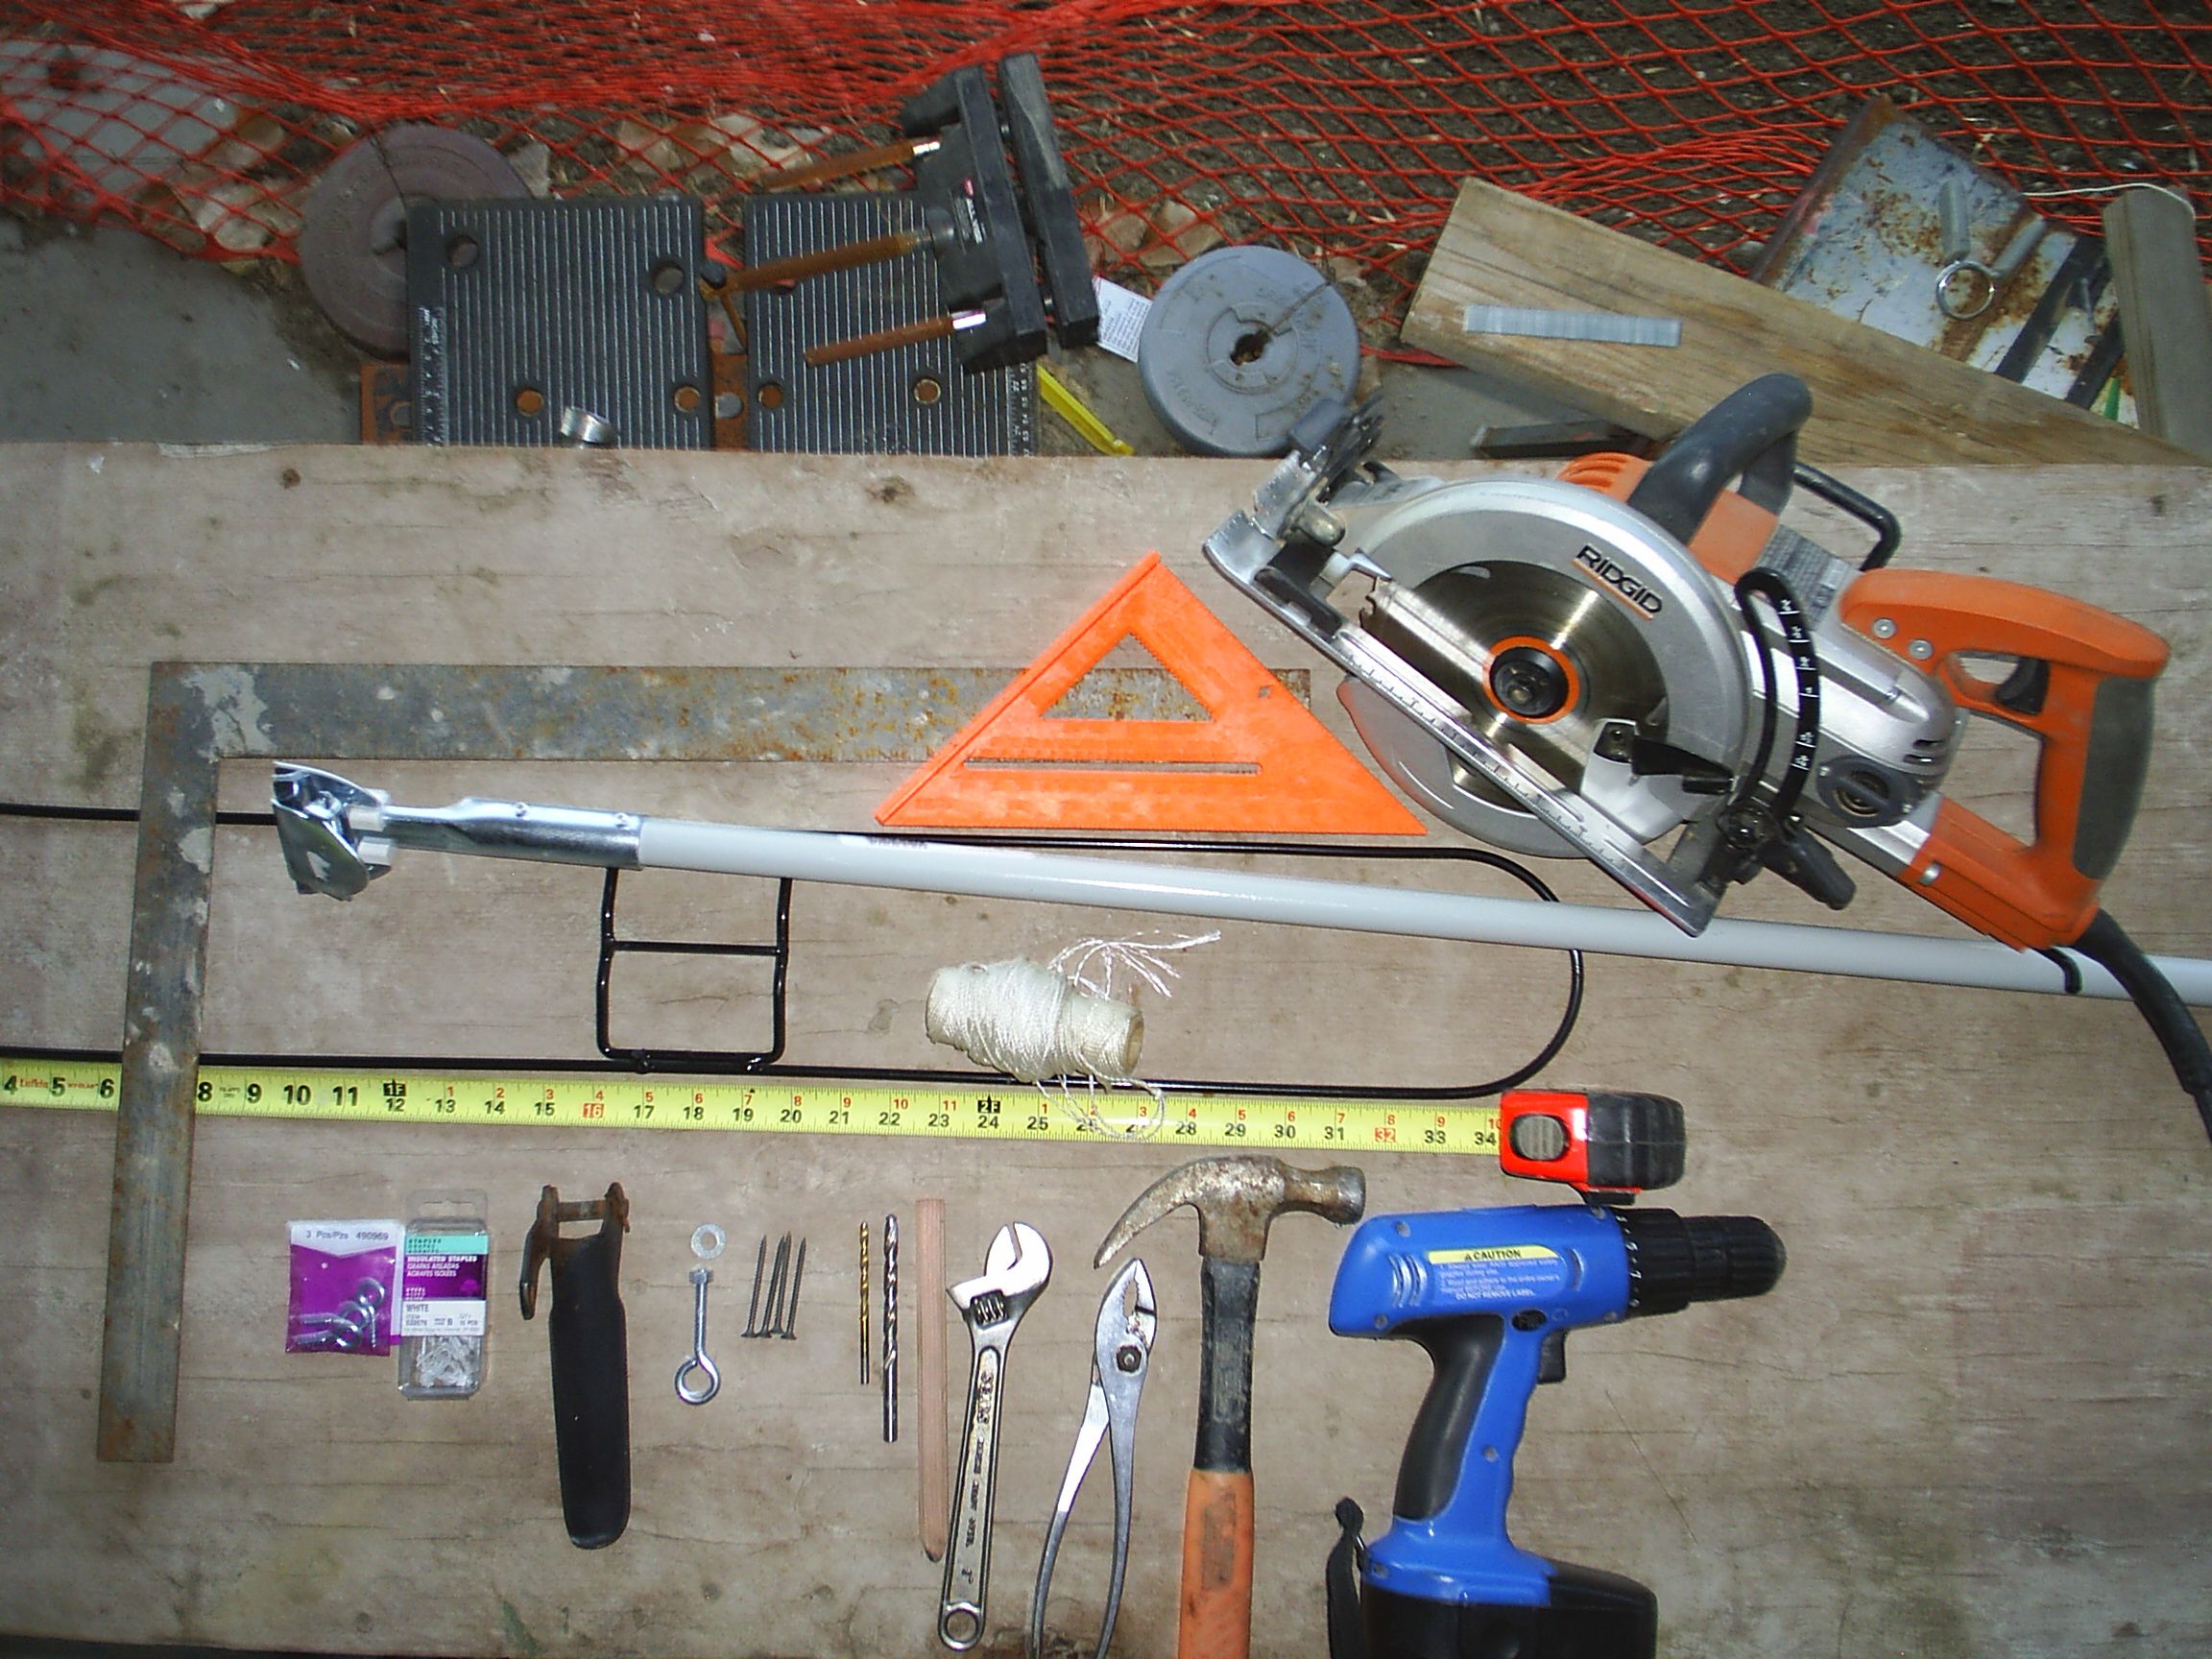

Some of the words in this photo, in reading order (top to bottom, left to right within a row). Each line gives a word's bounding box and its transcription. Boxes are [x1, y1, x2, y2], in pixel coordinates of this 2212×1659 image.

[1575, 543, 1663, 614] RIDGID
[4, 1075, 18, 1094] 4
[51, 1076, 65, 1096] 5
[100, 1078, 114, 1098] 6
[198, 1082, 212, 1102] 8
[247, 1083, 262, 1103] 9
[283, 1085, 311, 1105] 10
[333, 1086, 358, 1106] 11
[386, 1098, 405, 1111] 12
[435, 1098, 456, 1114] 13
[485, 1100, 505, 1115] 14
[534, 1102, 555, 1116] 15
[583, 1103, 604, 1118] 16
[634, 1105, 655, 1119] 17
[683, 1106, 704, 1120] 18
[733, 1108, 754, 1121] 19
[780, 1109, 802, 1123] 20
[829, 1111, 850, 1124] 21
[878, 1112, 901, 1126] 22
[928, 1113, 950, 1127] 23
[977, 1116, 999, 1129] 24
[1027, 1117, 1048, 1131] 25
[1175, 1120, 1197, 1135] 28
[1224, 1122, 1246, 1137] 29
[1274, 1124, 1296, 1139] 30
[1324, 1126, 1345, 1141] 31
[1375, 1128, 1396, 1142] 32
[1425, 1130, 1446, 1144] 33
[1475, 1132, 1497, 1145] 34
[447, 1087, 454, 1096] 1
[495, 1087, 505, 1098] 2
[545, 1089, 554, 1099] 3
[595, 1091, 604, 1100] 4
[645, 1092, 654, 1102] 5
[695, 1094, 703, 1103] 6
[744, 1094, 753, 1105] 7
[794, 1095, 803, 1106] 8
[843, 1097, 852, 1108] 9
[894, 1098, 909, 1109] 10
[943, 1100, 957, 1111] 11
[978, 1100, 1000, 1113] 2F
[1042, 1103, 1047, 1114] 1
[1140, 1106, 1147, 1117] 3
[1189, 1108, 1196, 1118] 4
[1238, 1110, 1246, 1120] 5
[1287, 1111, 1296, 1121] 6
[1337, 1113, 1346, 1123] 7
[1387, 1114, 1395, 1125] 8
[1437, 1117, 1445, 1127] 9
[1473, 1249, 1522, 1260] CAUTION
[406, 1304, 429, 1312] WHITE
